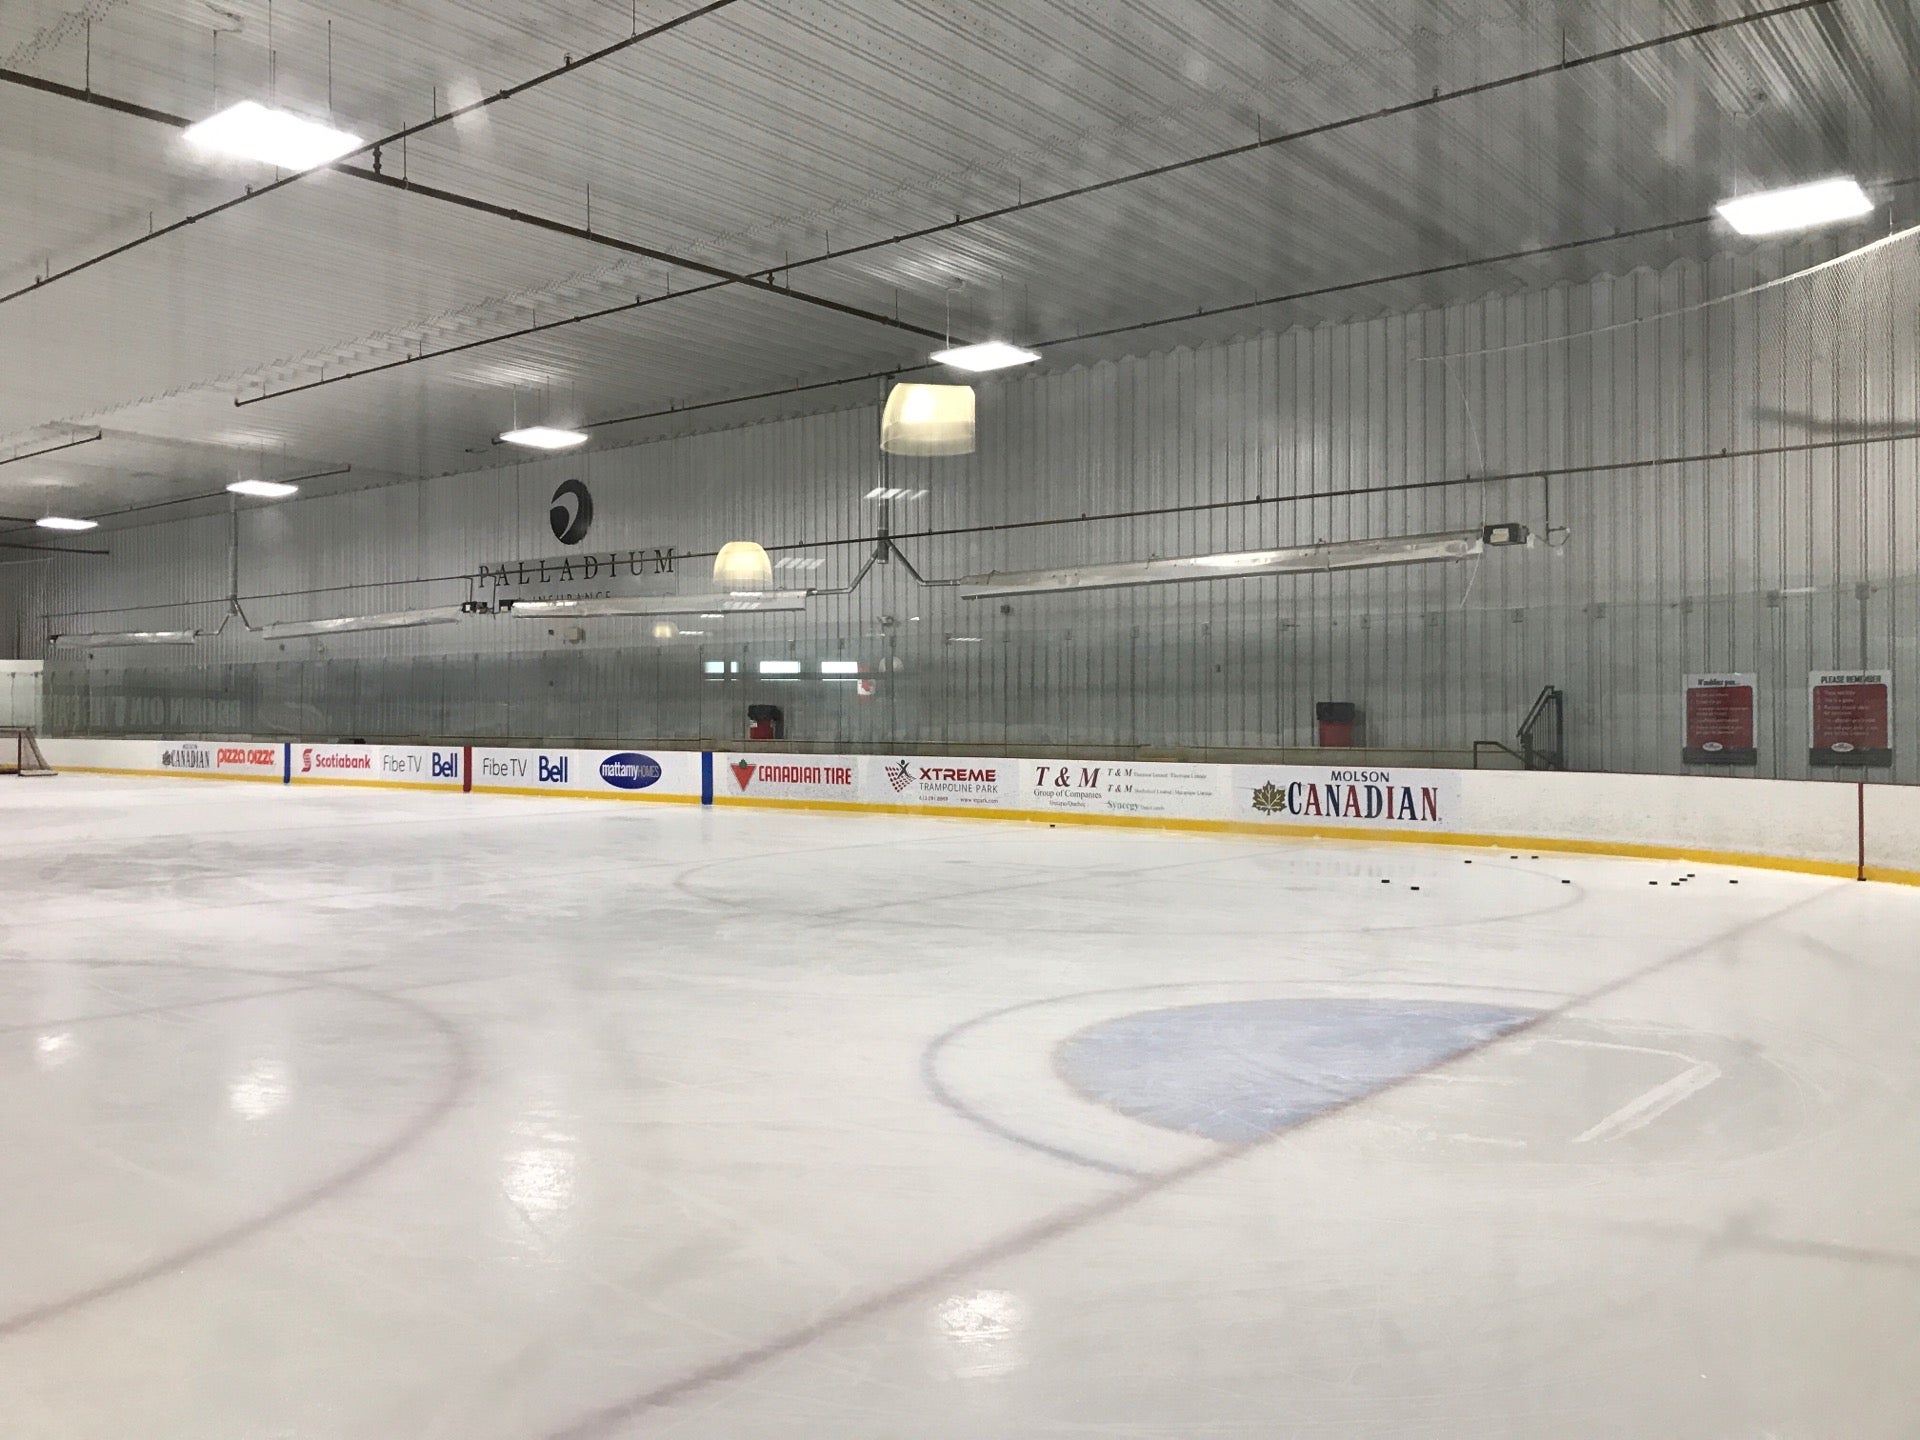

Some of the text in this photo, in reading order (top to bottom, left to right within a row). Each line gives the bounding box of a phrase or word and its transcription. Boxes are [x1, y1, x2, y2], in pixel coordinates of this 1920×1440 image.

[479, 548, 674, 588] PALLADIUM
[1821, 675, 1882, 684] PLEASE REMEMBER
[171, 749, 210, 768] CANADIAN
[217, 748, 246, 768] pizza
[316, 754, 371, 769] Scotiabank
[383, 755, 421, 772] Fibe TV
[432, 752, 458, 777] Bell
[483, 757, 527, 776] Fibe TV
[539, 755, 568, 783] Bell
[758, 764, 851, 784] CANADIAN TIRE
[919, 767, 997, 783] XTREME
[1036, 766, 1101, 788] T & M
[1107, 768, 1113, 777] T
[1115, 768, 1122, 776] &
[1124, 769, 1133, 777] M
[1331, 770, 1390, 782] MOLSON
[919, 782, 998, 793] TRAMPOLINE PARK
[1033, 789, 1102, 799] Group of Companies
[1107, 785, 1113, 793] T
[1115, 785, 1122, 793] &
[1124, 785, 1133, 793] M
[1107, 800, 1139, 811] Synergy
[1288, 782, 1438, 821] CANADIAN
